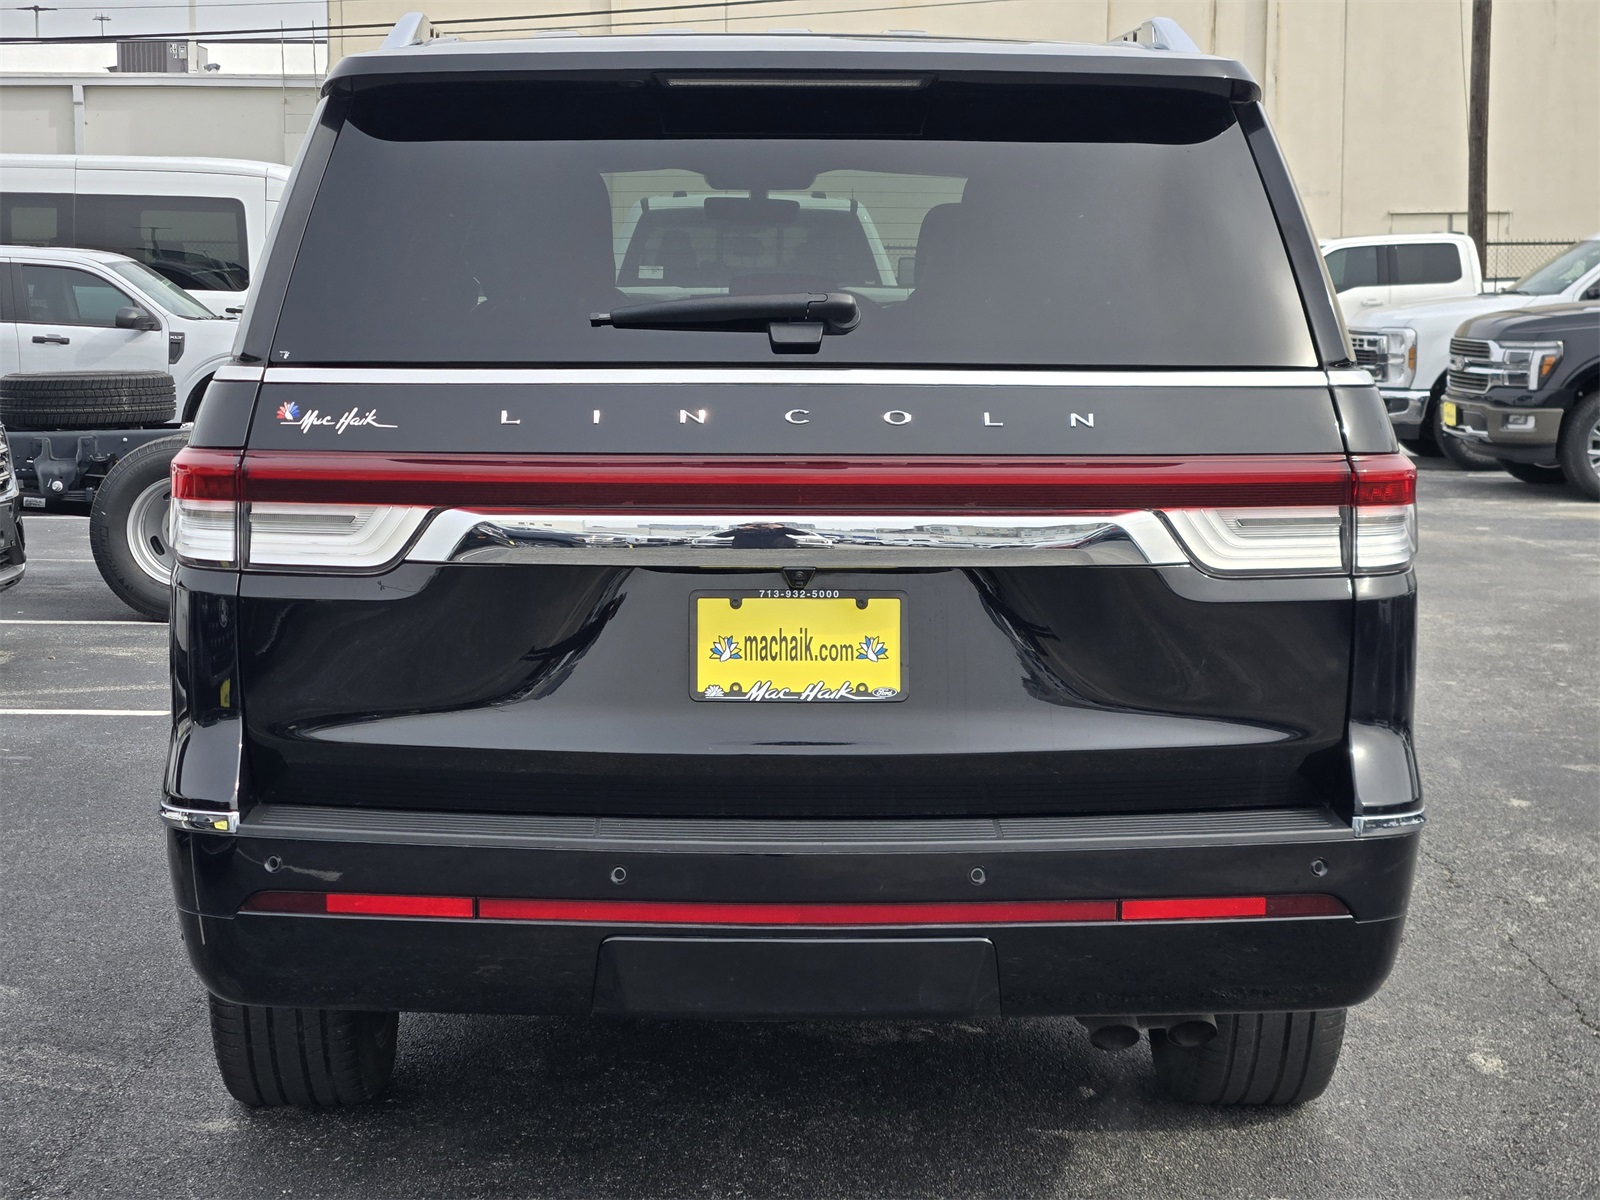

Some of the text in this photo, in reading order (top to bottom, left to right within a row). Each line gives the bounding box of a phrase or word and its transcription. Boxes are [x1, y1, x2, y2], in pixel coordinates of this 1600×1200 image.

[335, 407, 383, 434] Haik
[500, 409, 1095, 428] LINCOLN
[758, 589, 840, 599] 713-932-5000
[743, 627, 854, 662] machaik.com
[748, 680, 856, 702] Mac Haik
